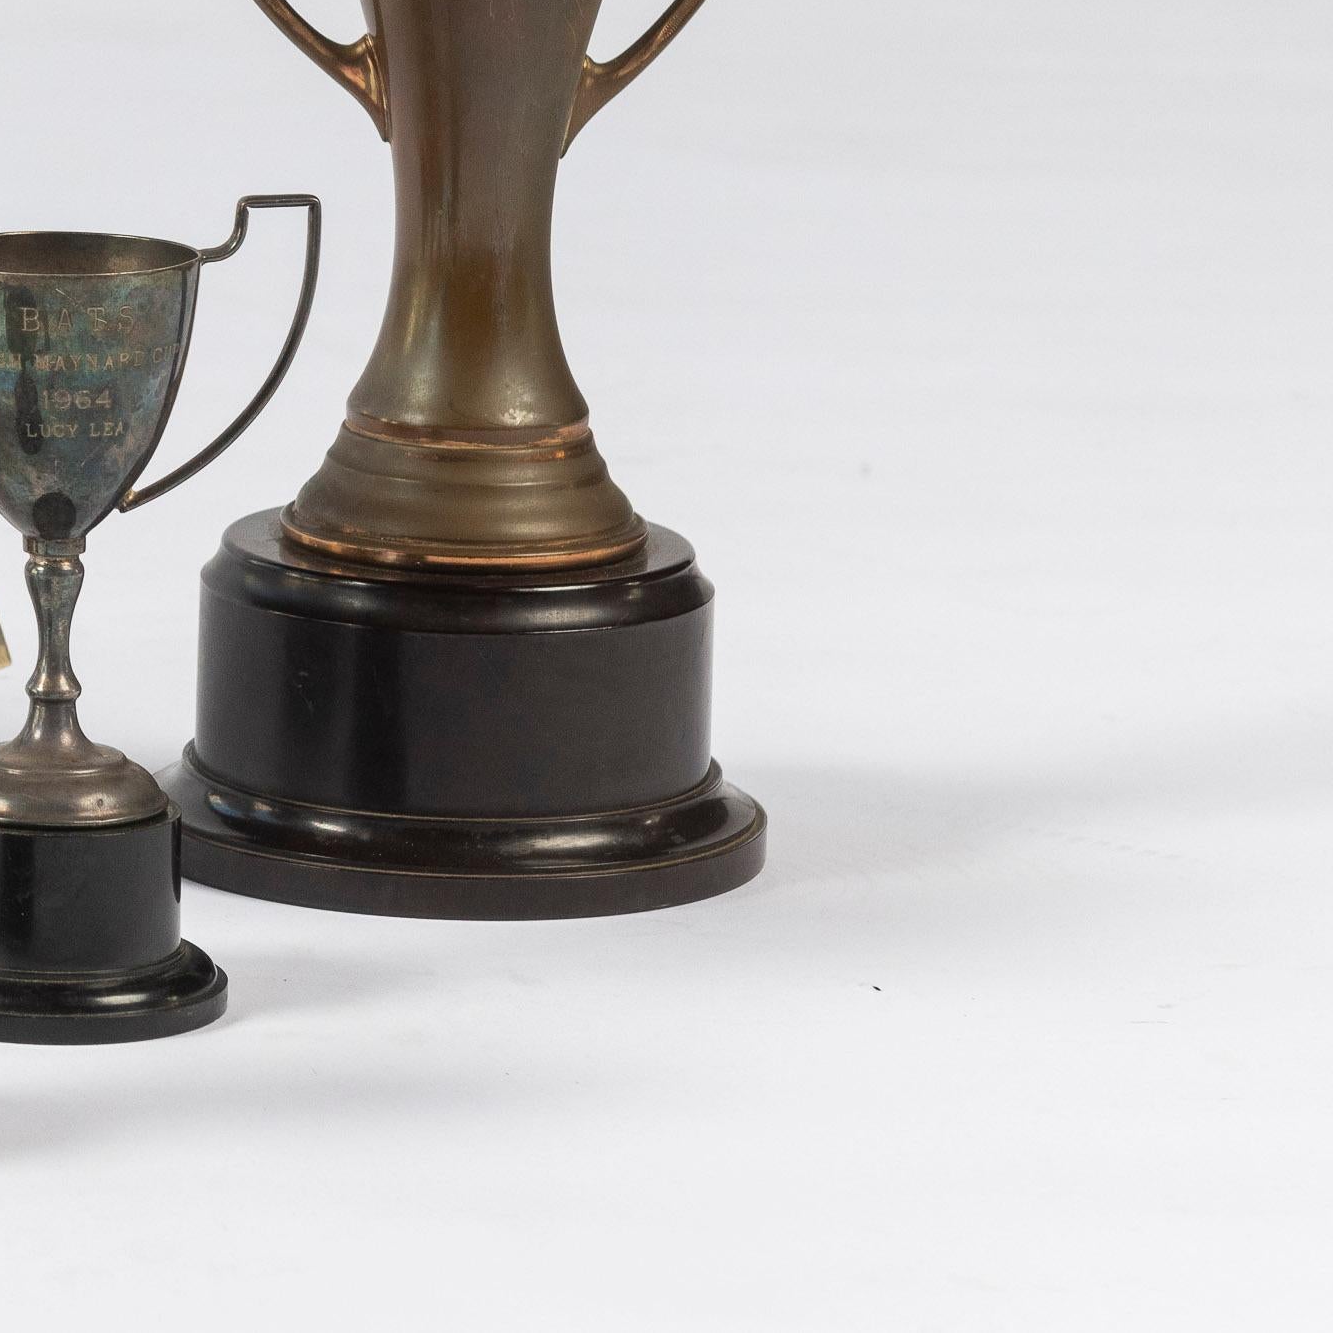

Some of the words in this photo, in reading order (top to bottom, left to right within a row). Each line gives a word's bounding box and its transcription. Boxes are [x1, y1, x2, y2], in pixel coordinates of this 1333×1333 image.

[41, 388, 112, 410] 1964
[25, 423, 78, 438] LUCY
[89, 421, 124, 438] LEA
